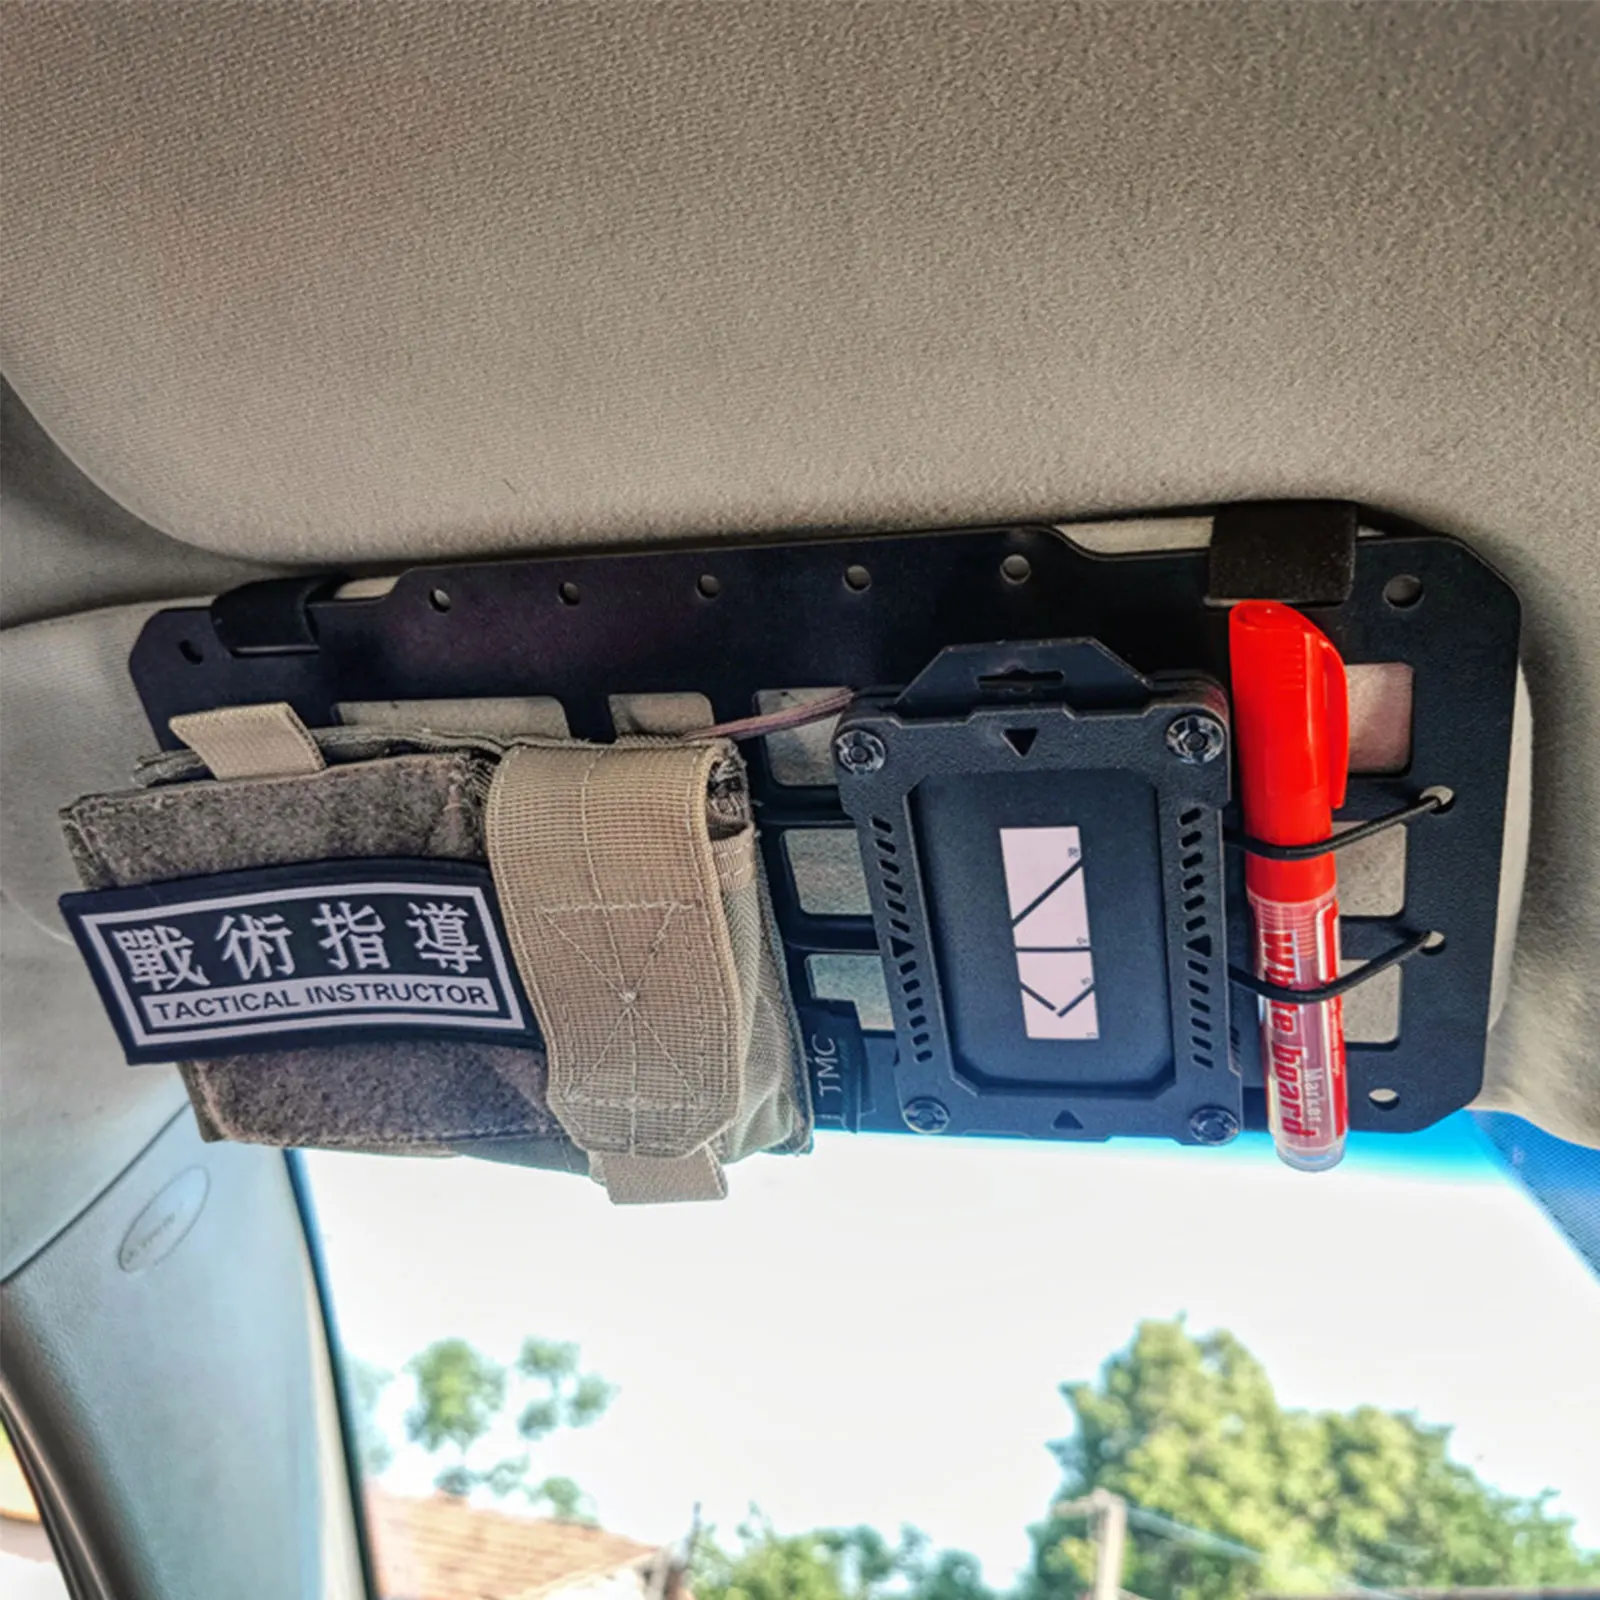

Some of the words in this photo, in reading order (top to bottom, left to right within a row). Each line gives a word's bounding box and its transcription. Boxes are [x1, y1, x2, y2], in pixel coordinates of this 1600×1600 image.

[112, 902, 484, 992] 戰術指導
[1261, 929, 1302, 1035] Whte
[152, 989, 301, 1021] TACTICAL
[305, 982, 489, 1007] INSTRUCTOR
[811, 1033, 842, 1098] TMC
[1271, 1044, 1318, 1138] board
[1304, 1067, 1325, 1123] Marker
